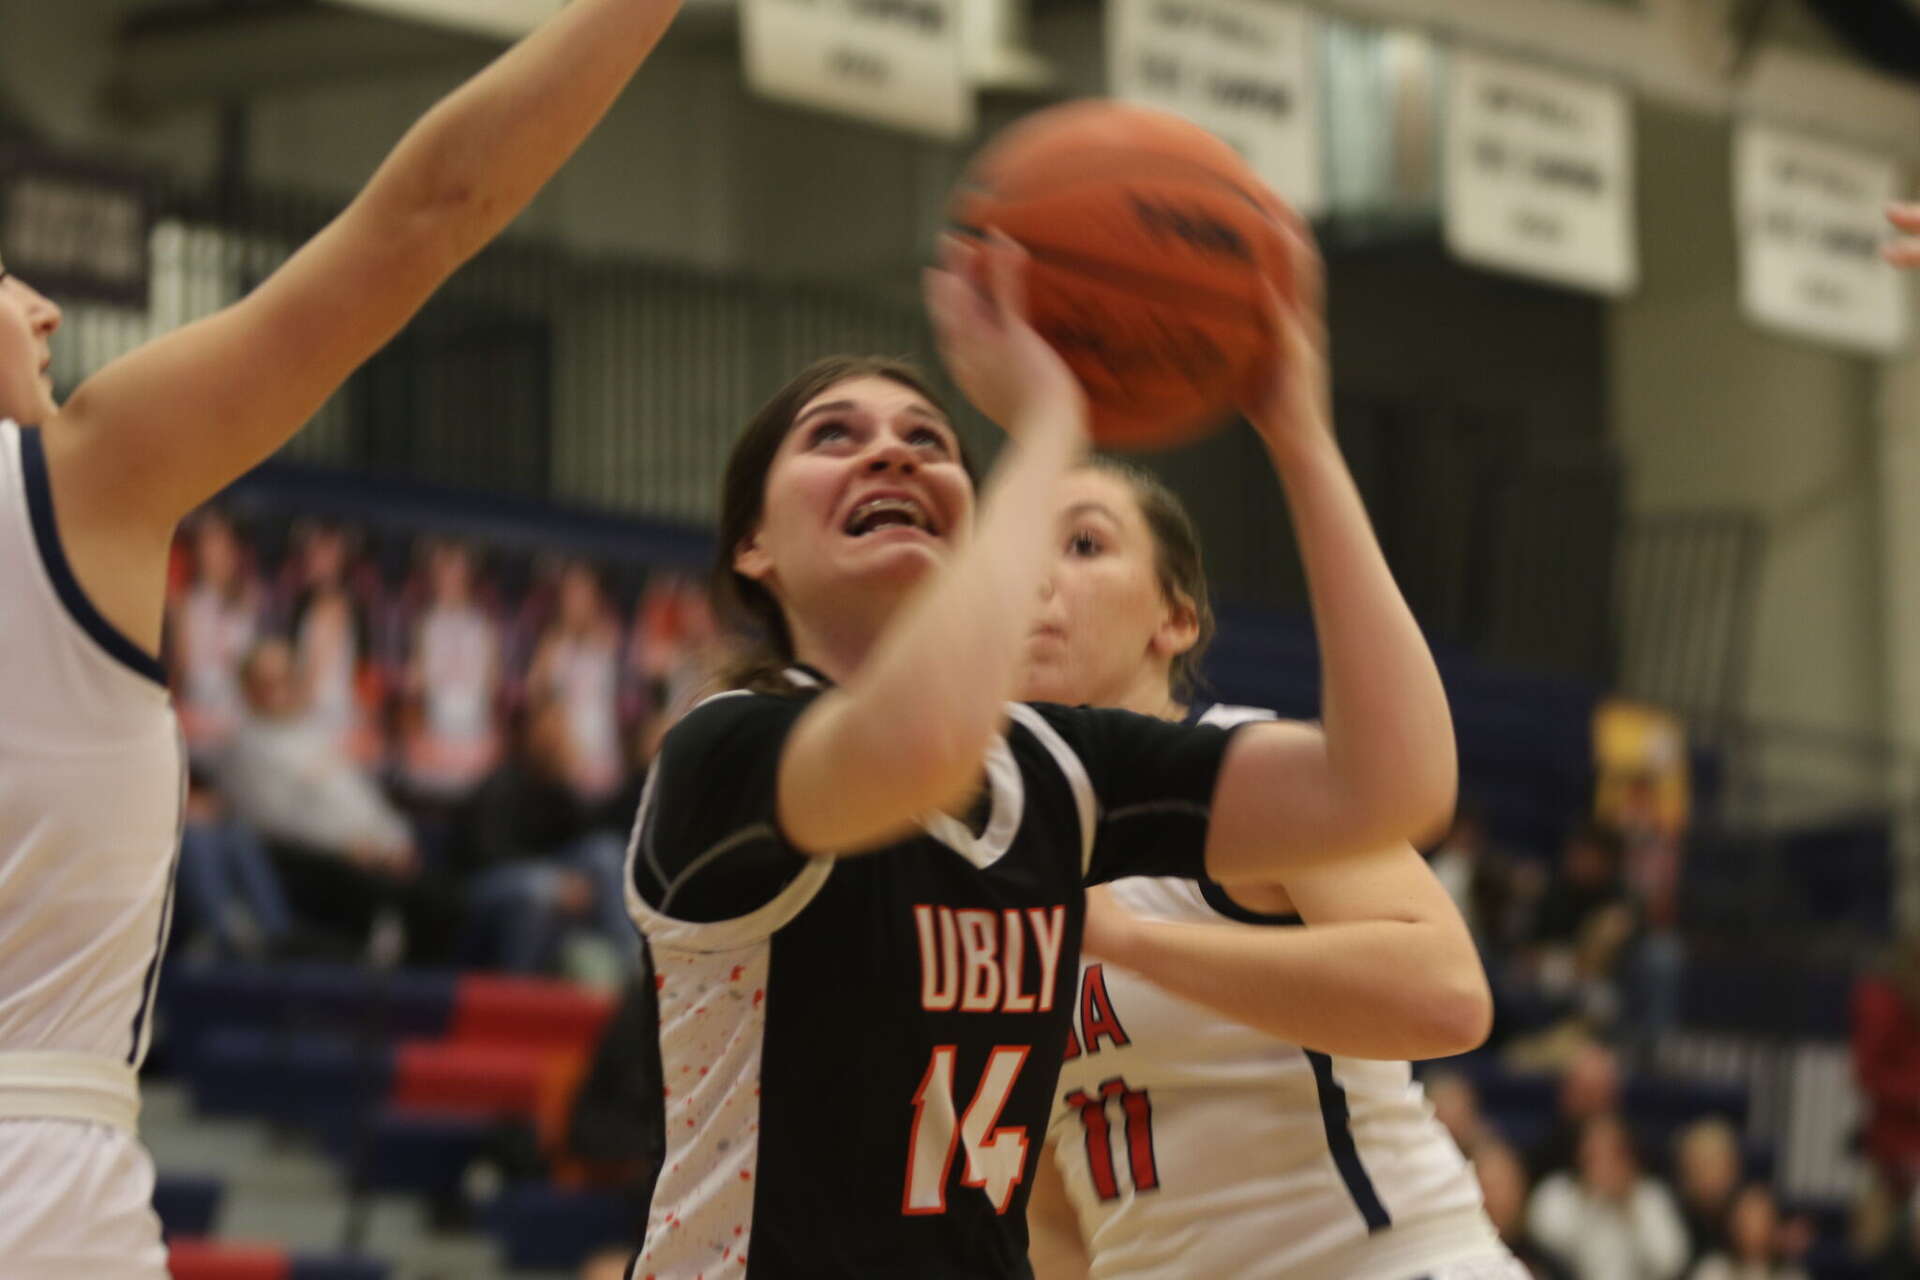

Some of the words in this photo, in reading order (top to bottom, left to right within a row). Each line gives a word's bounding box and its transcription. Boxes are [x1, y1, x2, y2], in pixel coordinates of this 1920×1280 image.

[913, 904, 1066, 1012] UBLY
[1063, 963, 1131, 1062] A
[902, 1044, 1032, 1215] 14
[1064, 1076, 1159, 1203] 11
